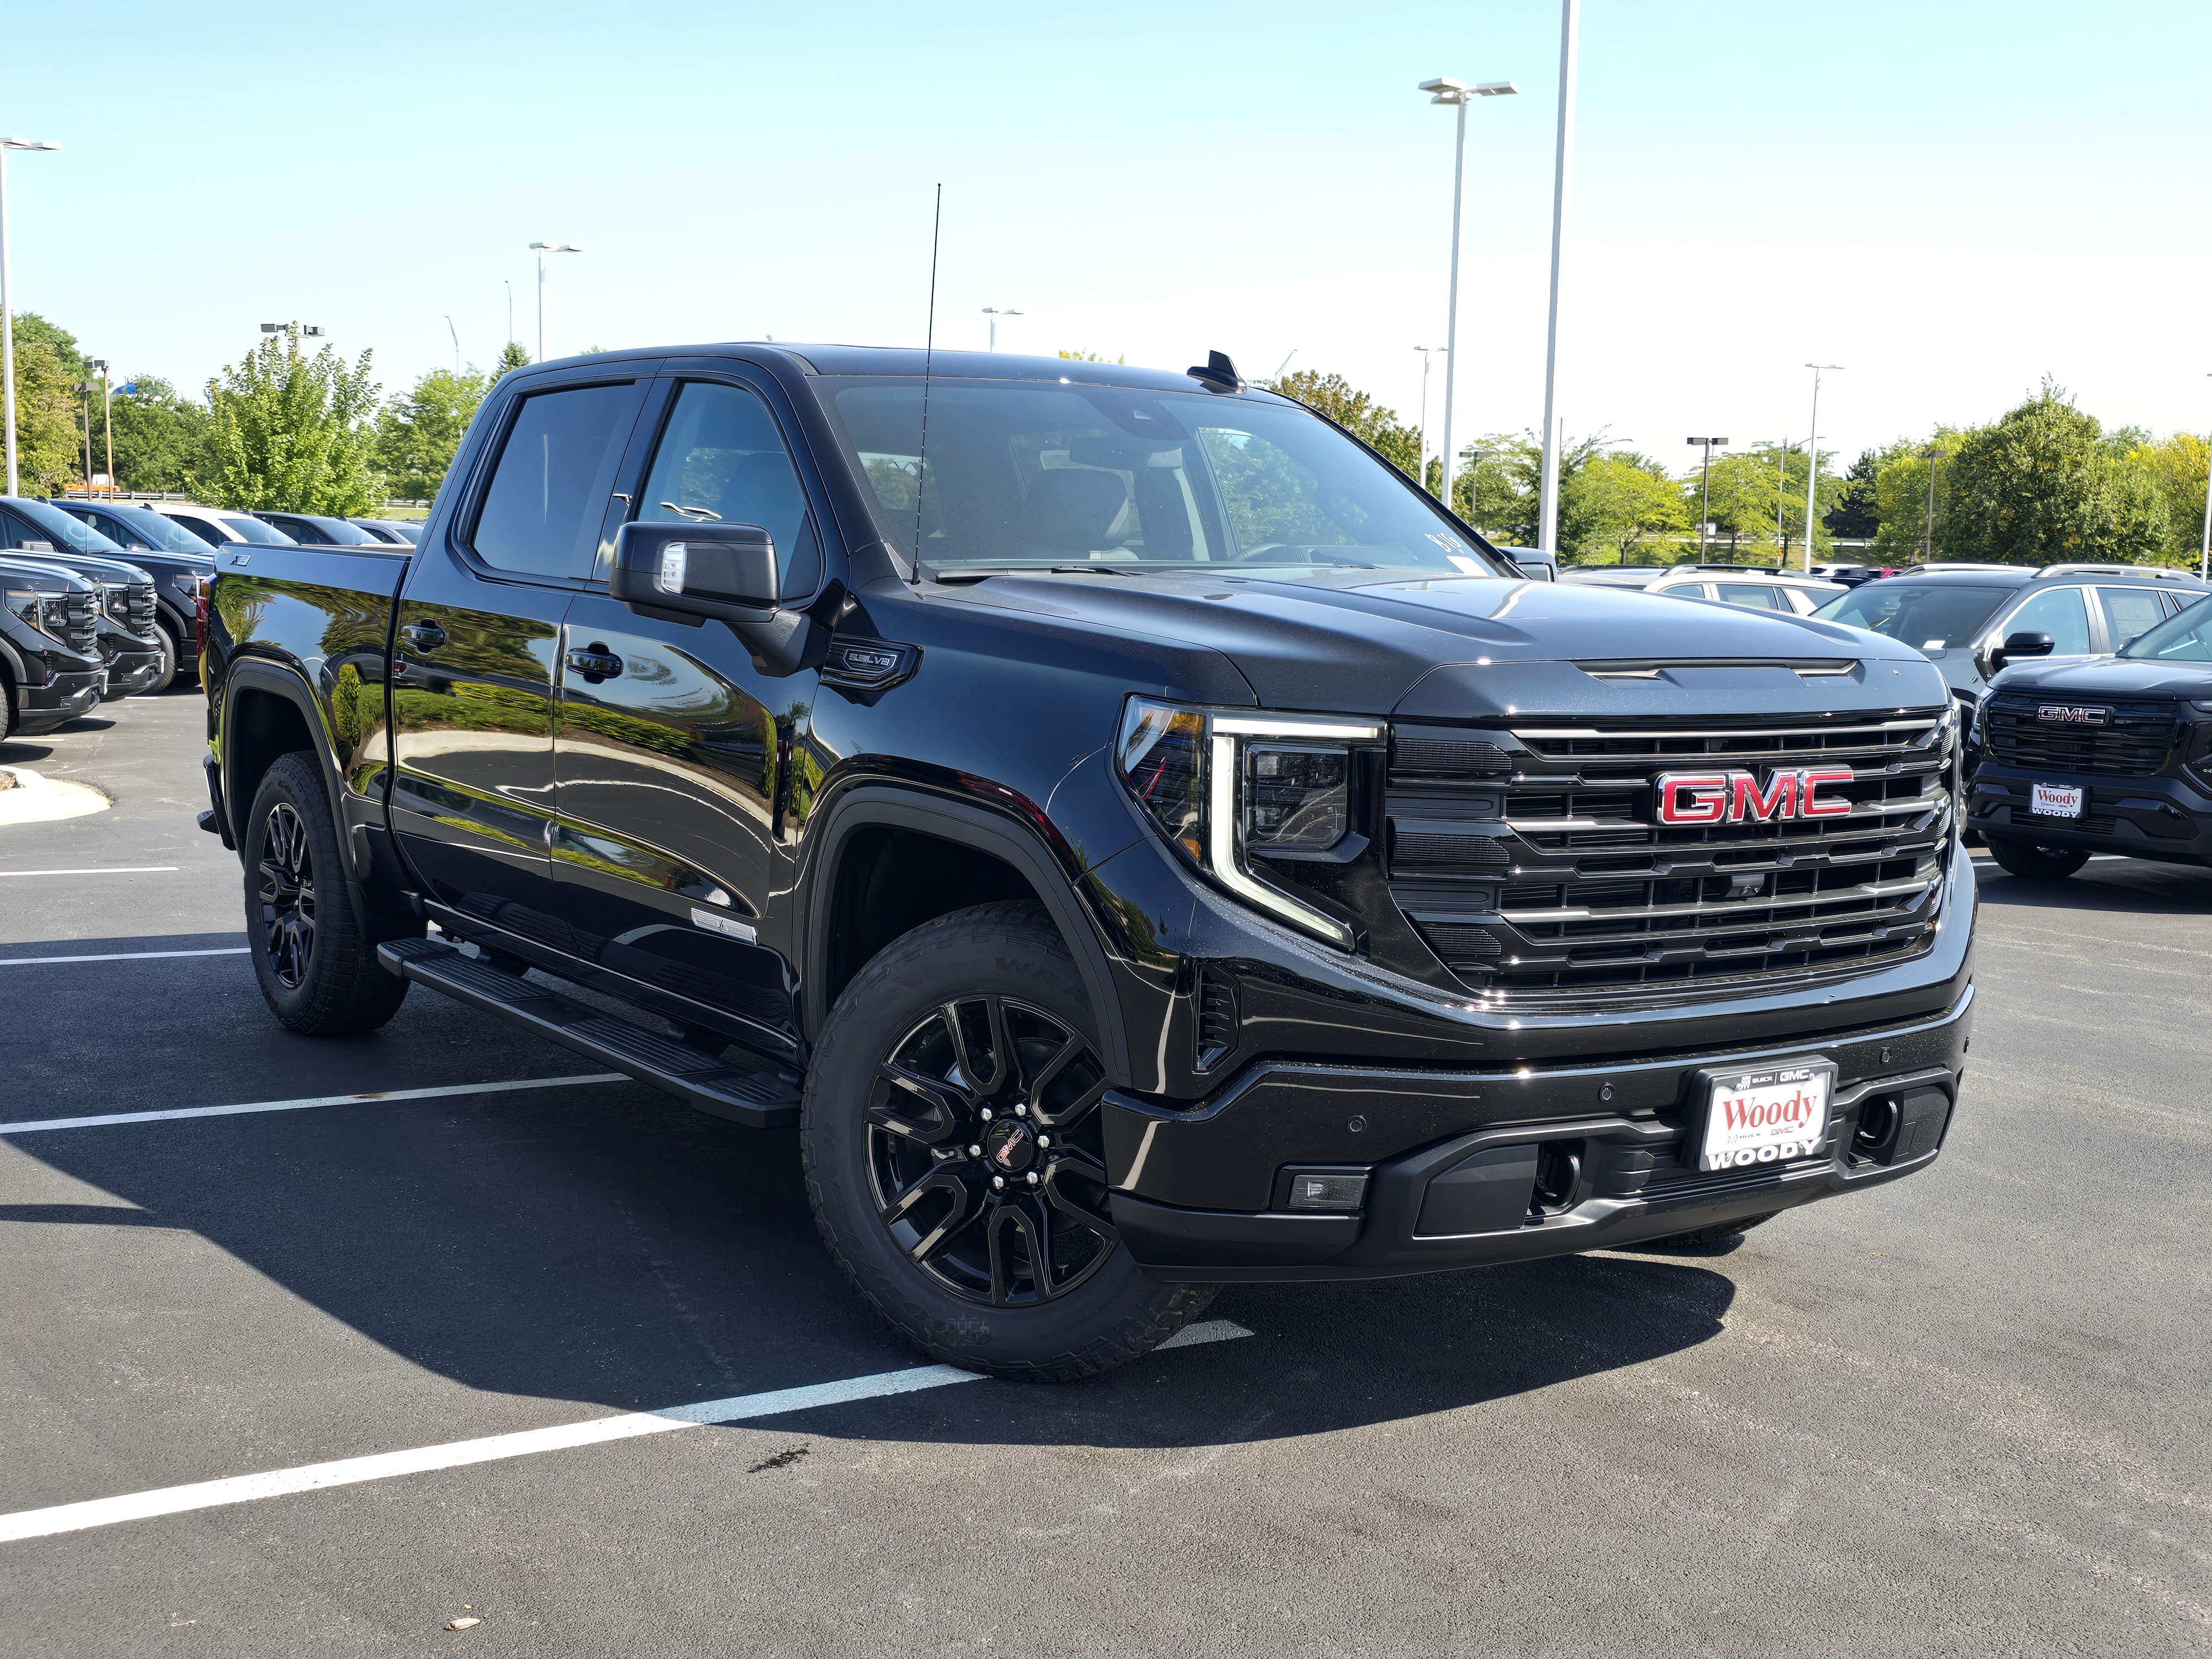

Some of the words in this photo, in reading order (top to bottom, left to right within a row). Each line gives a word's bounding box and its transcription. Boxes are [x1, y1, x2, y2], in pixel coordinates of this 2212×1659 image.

[2038, 706, 2105, 724] GMC
[1657, 769, 1854, 825] GMC
[2038, 790, 2078, 807] Woody
[2032, 808, 2078, 818] WOODY
[1780, 1069, 1809, 1082] GMC
[1723, 1090, 1817, 1130] Woody
[996, 1129, 1024, 1163] GMC
[1708, 1136, 1822, 1171] WOODY
